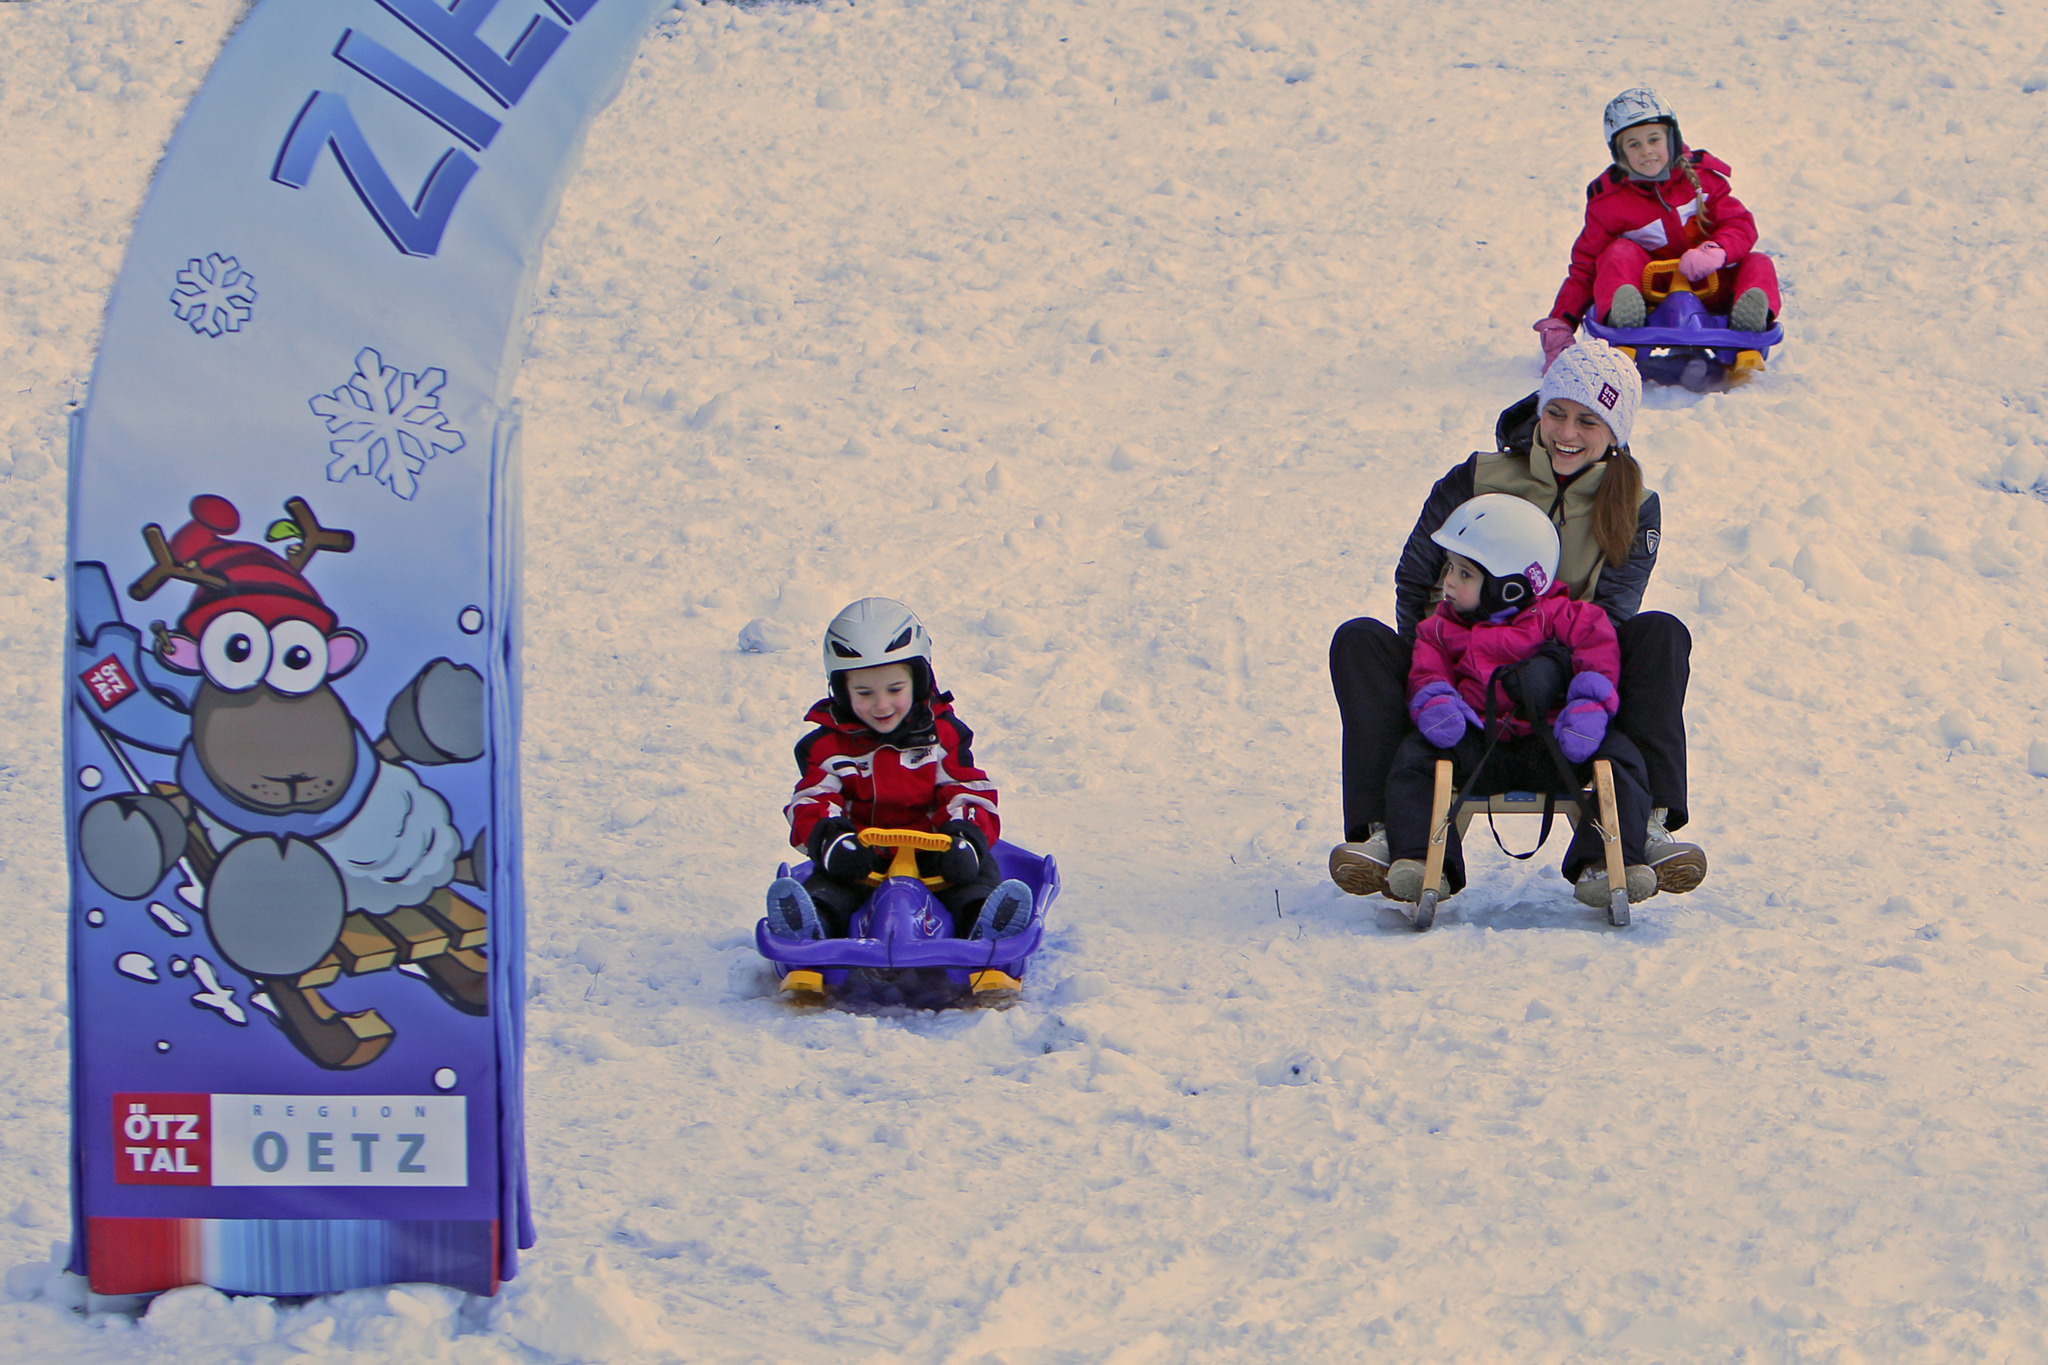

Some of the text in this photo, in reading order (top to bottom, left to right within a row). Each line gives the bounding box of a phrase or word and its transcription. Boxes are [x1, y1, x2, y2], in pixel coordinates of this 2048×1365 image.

[270, 0, 602, 259] ZIE
[90, 672, 112, 701] TAL
[101, 663, 128, 693] ÖTZ
[124, 1103, 199, 1140] ÖTZ
[253, 1104, 426, 1118] REGION
[125, 1147, 199, 1173] TAL
[252, 1130, 427, 1173] OETZ
